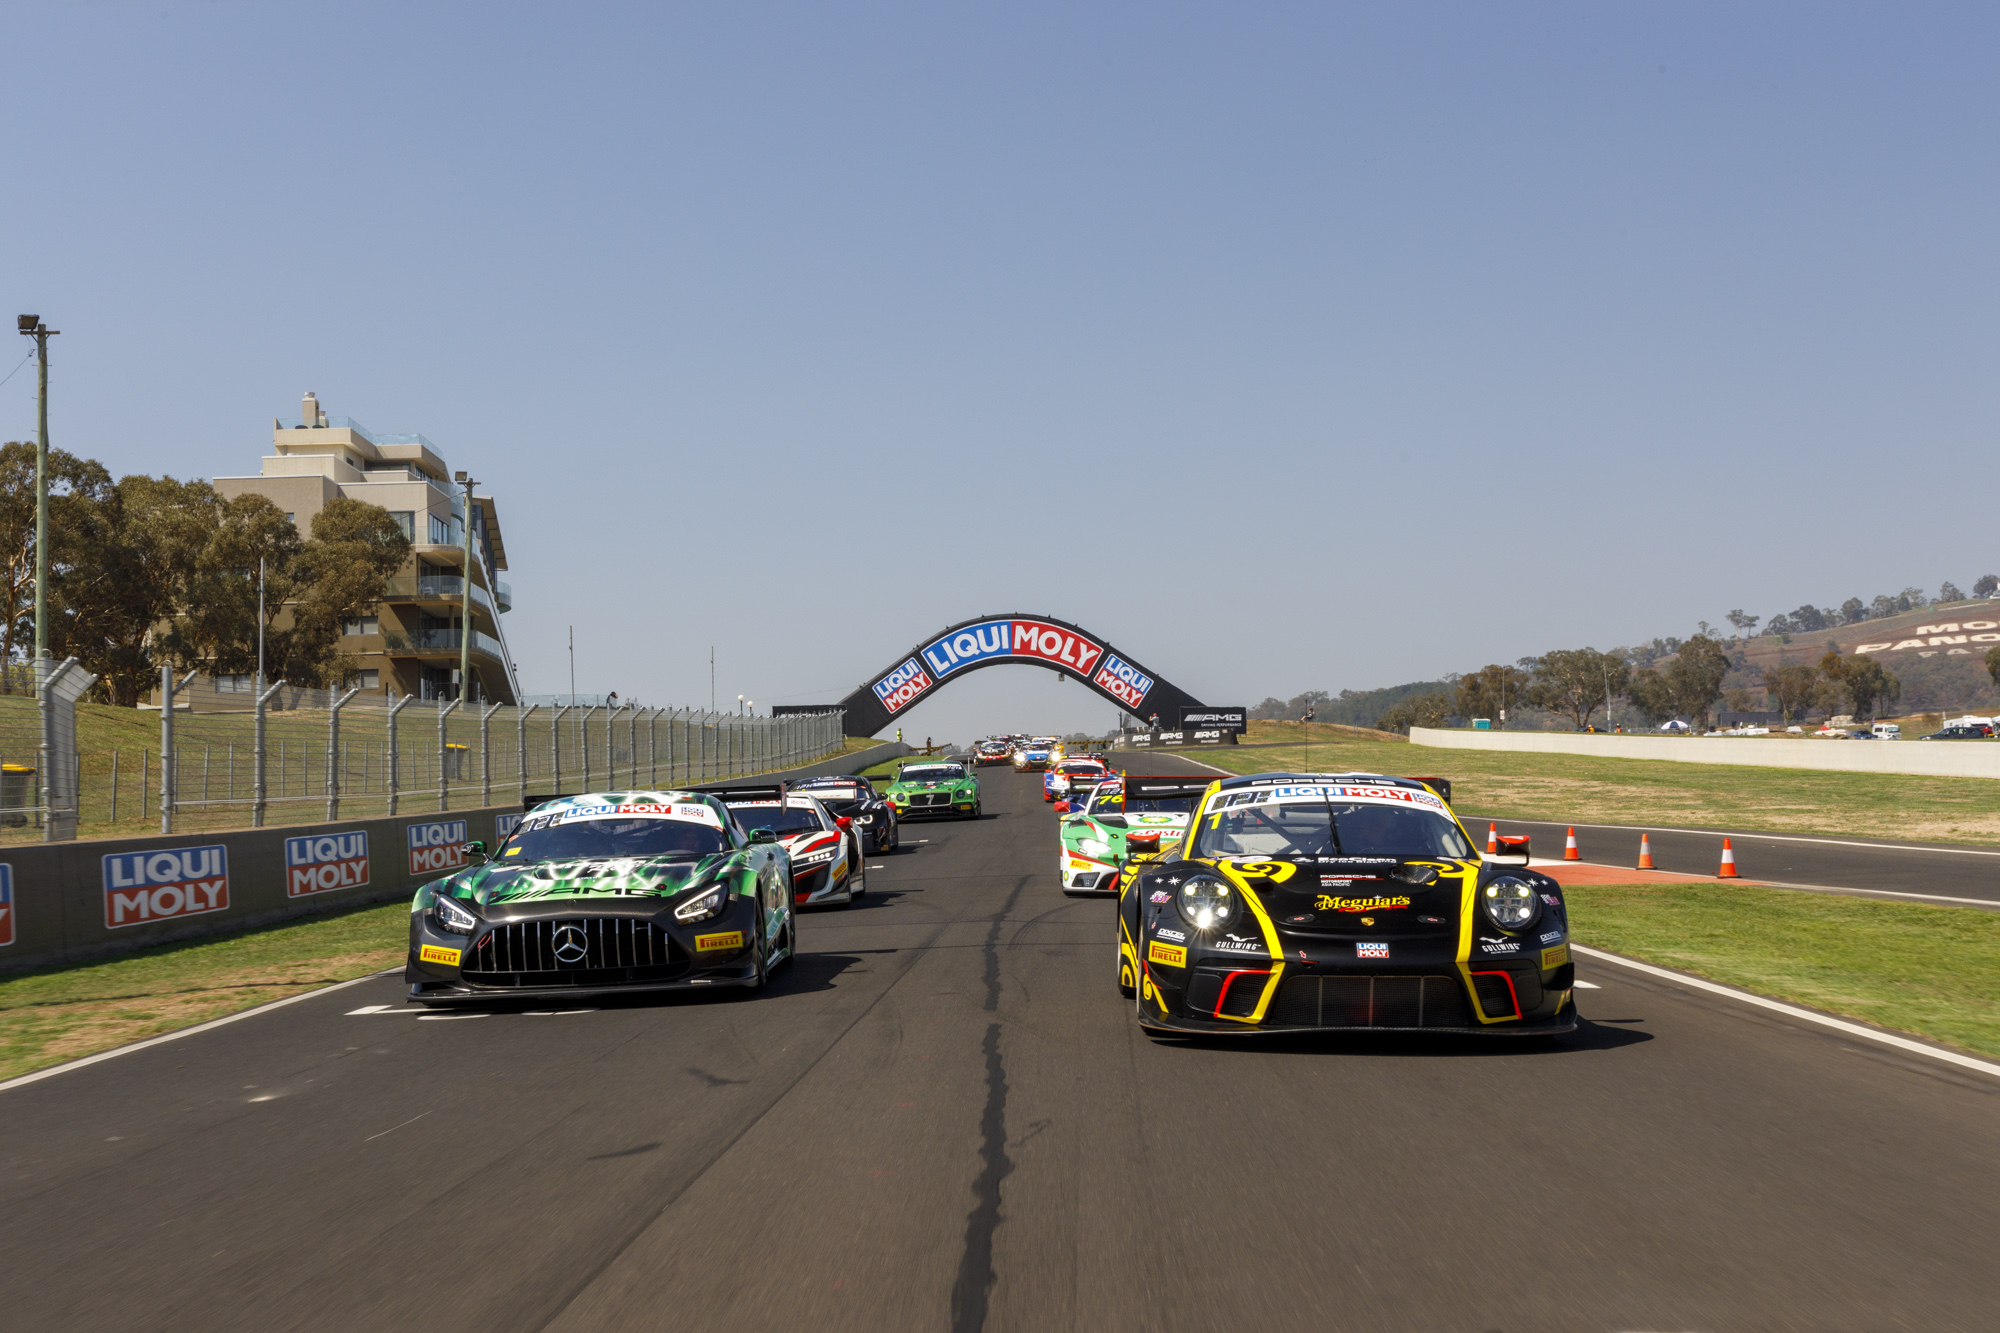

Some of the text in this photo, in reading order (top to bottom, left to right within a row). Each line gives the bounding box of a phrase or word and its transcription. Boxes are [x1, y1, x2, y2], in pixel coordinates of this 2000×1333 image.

[1916, 621, 2000, 635] MO
[928, 622, 1100, 671] LIQUI MOLY
[876, 658, 919, 699] LIQUI
[1104, 656, 1152, 691] LIQUI
[887, 672, 929, 713] MOLY
[1098, 671, 1143, 707] MOLY
[1252, 778, 1397, 786] PORSCHE
[1099, 795, 1123, 805] 76
[1279, 788, 1409, 800] LIQUI MOLY
[567, 804, 671, 818] LIQUI MOLY
[498, 816, 522, 836] LIQ
[1208, 812, 1222, 830] 1
[410, 821, 465, 848] LIQUI
[1145, 830, 1184, 838] Castr
[290, 833, 364, 863] LIQUI
[412, 844, 466, 874] MOLY
[111, 849, 221, 888] LIQUI
[293, 860, 367, 894] MOLY
[113, 879, 225, 923] MOLY
[1314, 894, 1411, 912] Meguiar's
[699, 933, 741, 949] PIRELLI
[1215, 941, 1257, 950] GULLWING
[1358, 943, 1387, 951] LIQUI
[1481, 943, 1519, 953] GULLWING
[424, 946, 459, 964] PIRELLI
[1151, 945, 1182, 963] PIRELLI
[1359, 950, 1387, 958] MOLY
[1545, 948, 1565, 965] PIRELLI
